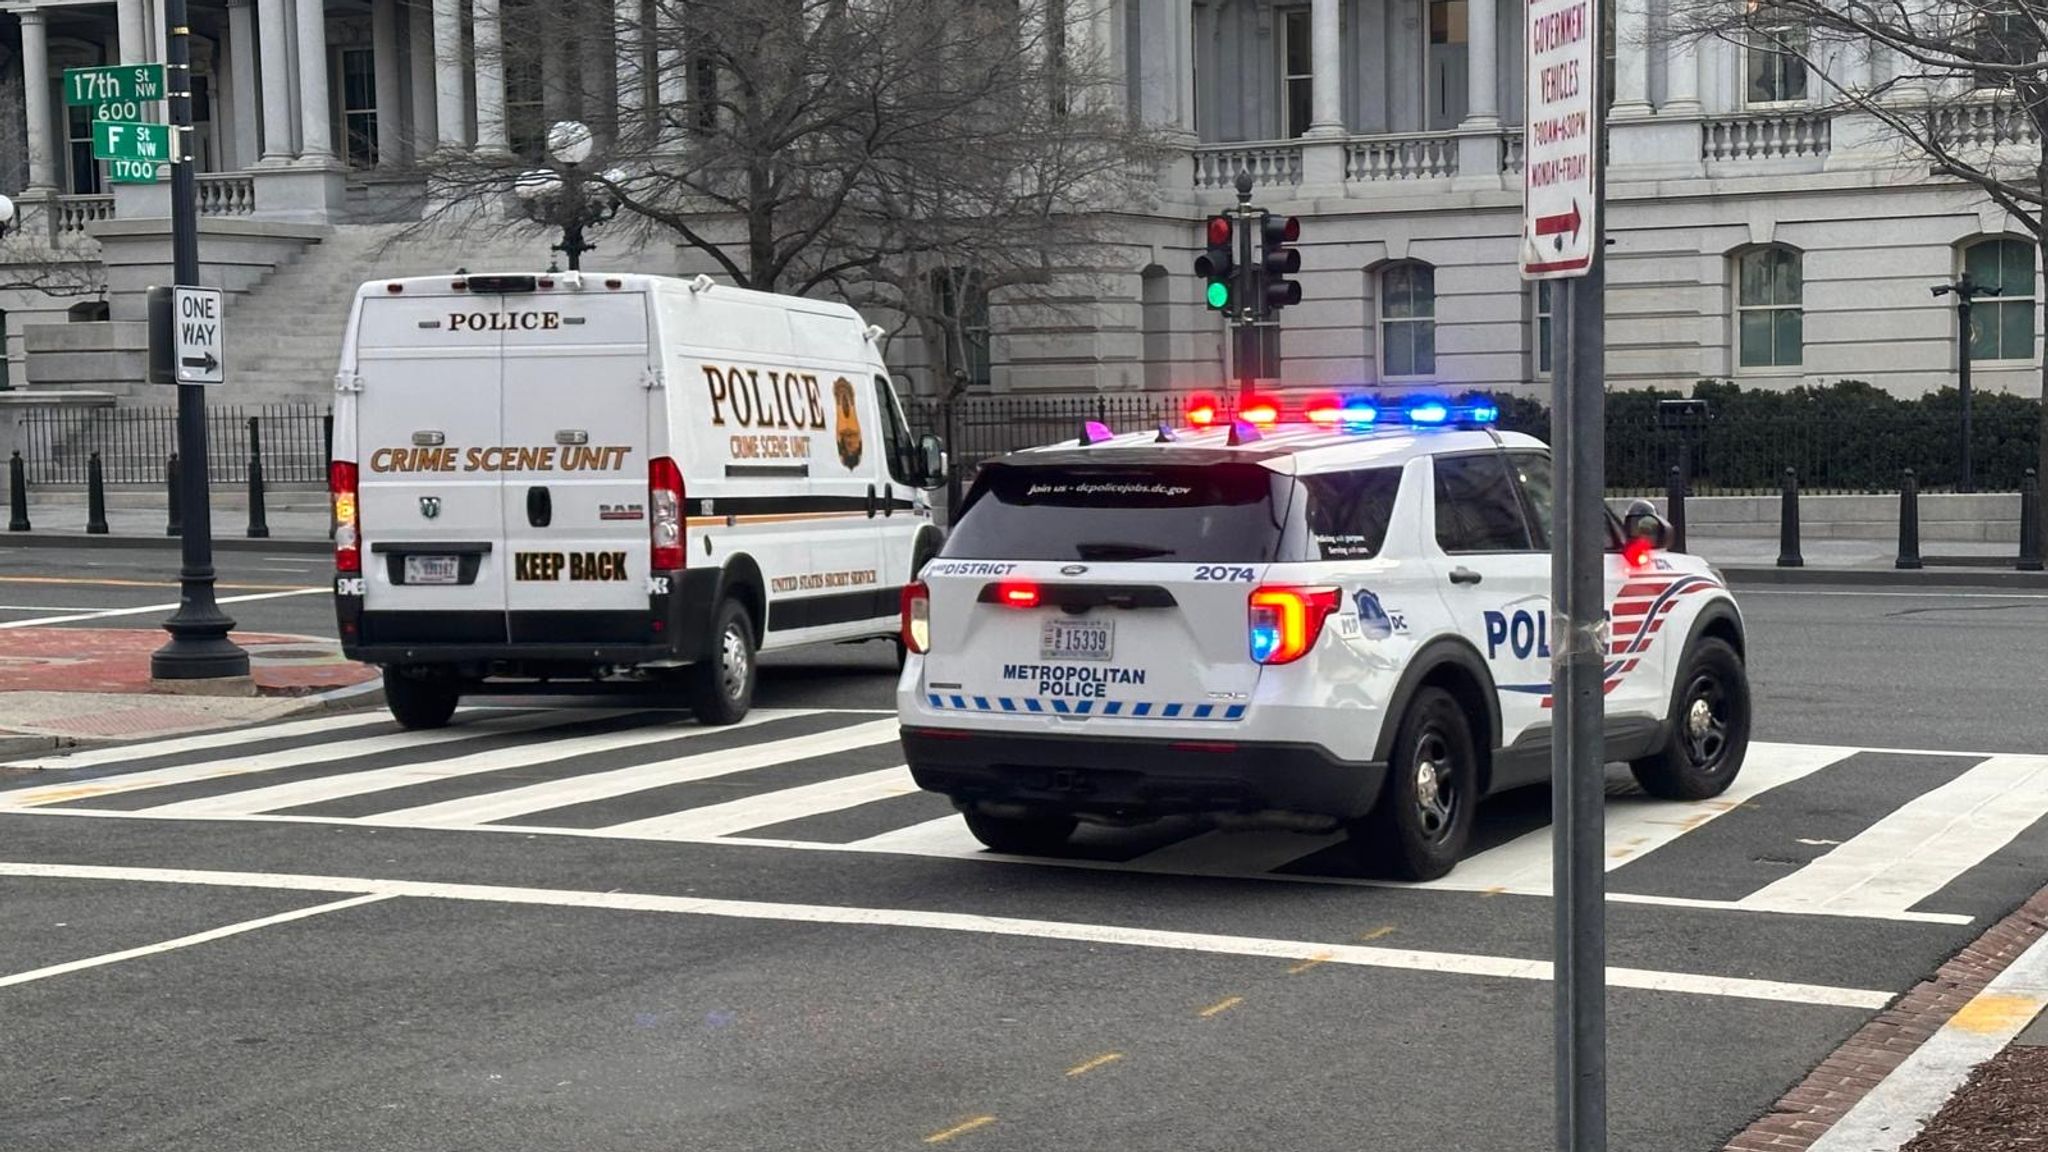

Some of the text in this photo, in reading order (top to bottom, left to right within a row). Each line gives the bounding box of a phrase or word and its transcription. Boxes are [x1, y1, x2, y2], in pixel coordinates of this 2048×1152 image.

[1534, 3, 1585, 54] GOVERNMENT
[73, 69, 149, 99] 17th St
[135, 83, 156, 97] NW
[1541, 59, 1579, 105] VEHICLES
[98, 101, 136, 121] 600
[107, 125, 150, 154] F St
[136, 141, 156, 157] NW
[115, 160, 152, 178] 1700
[1531, 154, 1587, 187] MONDAY-FRIDAY
[182, 296, 215, 319] ONE
[448, 312, 559, 331] POLICE
[182, 323, 216, 346] WAY
[702, 365, 826, 431] POLICE
[730, 435, 810, 459] CRIME SCENE UNIT
[370, 446, 632, 473] CRIME SCENE UNIT
[1053, 485, 1068, 493] us
[1076, 483, 1191, 496] dcpolicejobs.dc.gov
[515, 552, 628, 581] KEEP BACK
[945, 562, 1017, 576] DISTRICT
[1194, 566, 1255, 582] 2074
[772, 576, 798, 593] UNITED
[799, 574, 824, 590] STATES
[850, 569, 876, 584] SERVICE
[1390, 615, 1407, 630] DC
[1066, 629, 1106, 650] 15339
[1003, 664, 1146, 684] METROPOLITAN
[1039, 681, 1106, 698] POLICE
